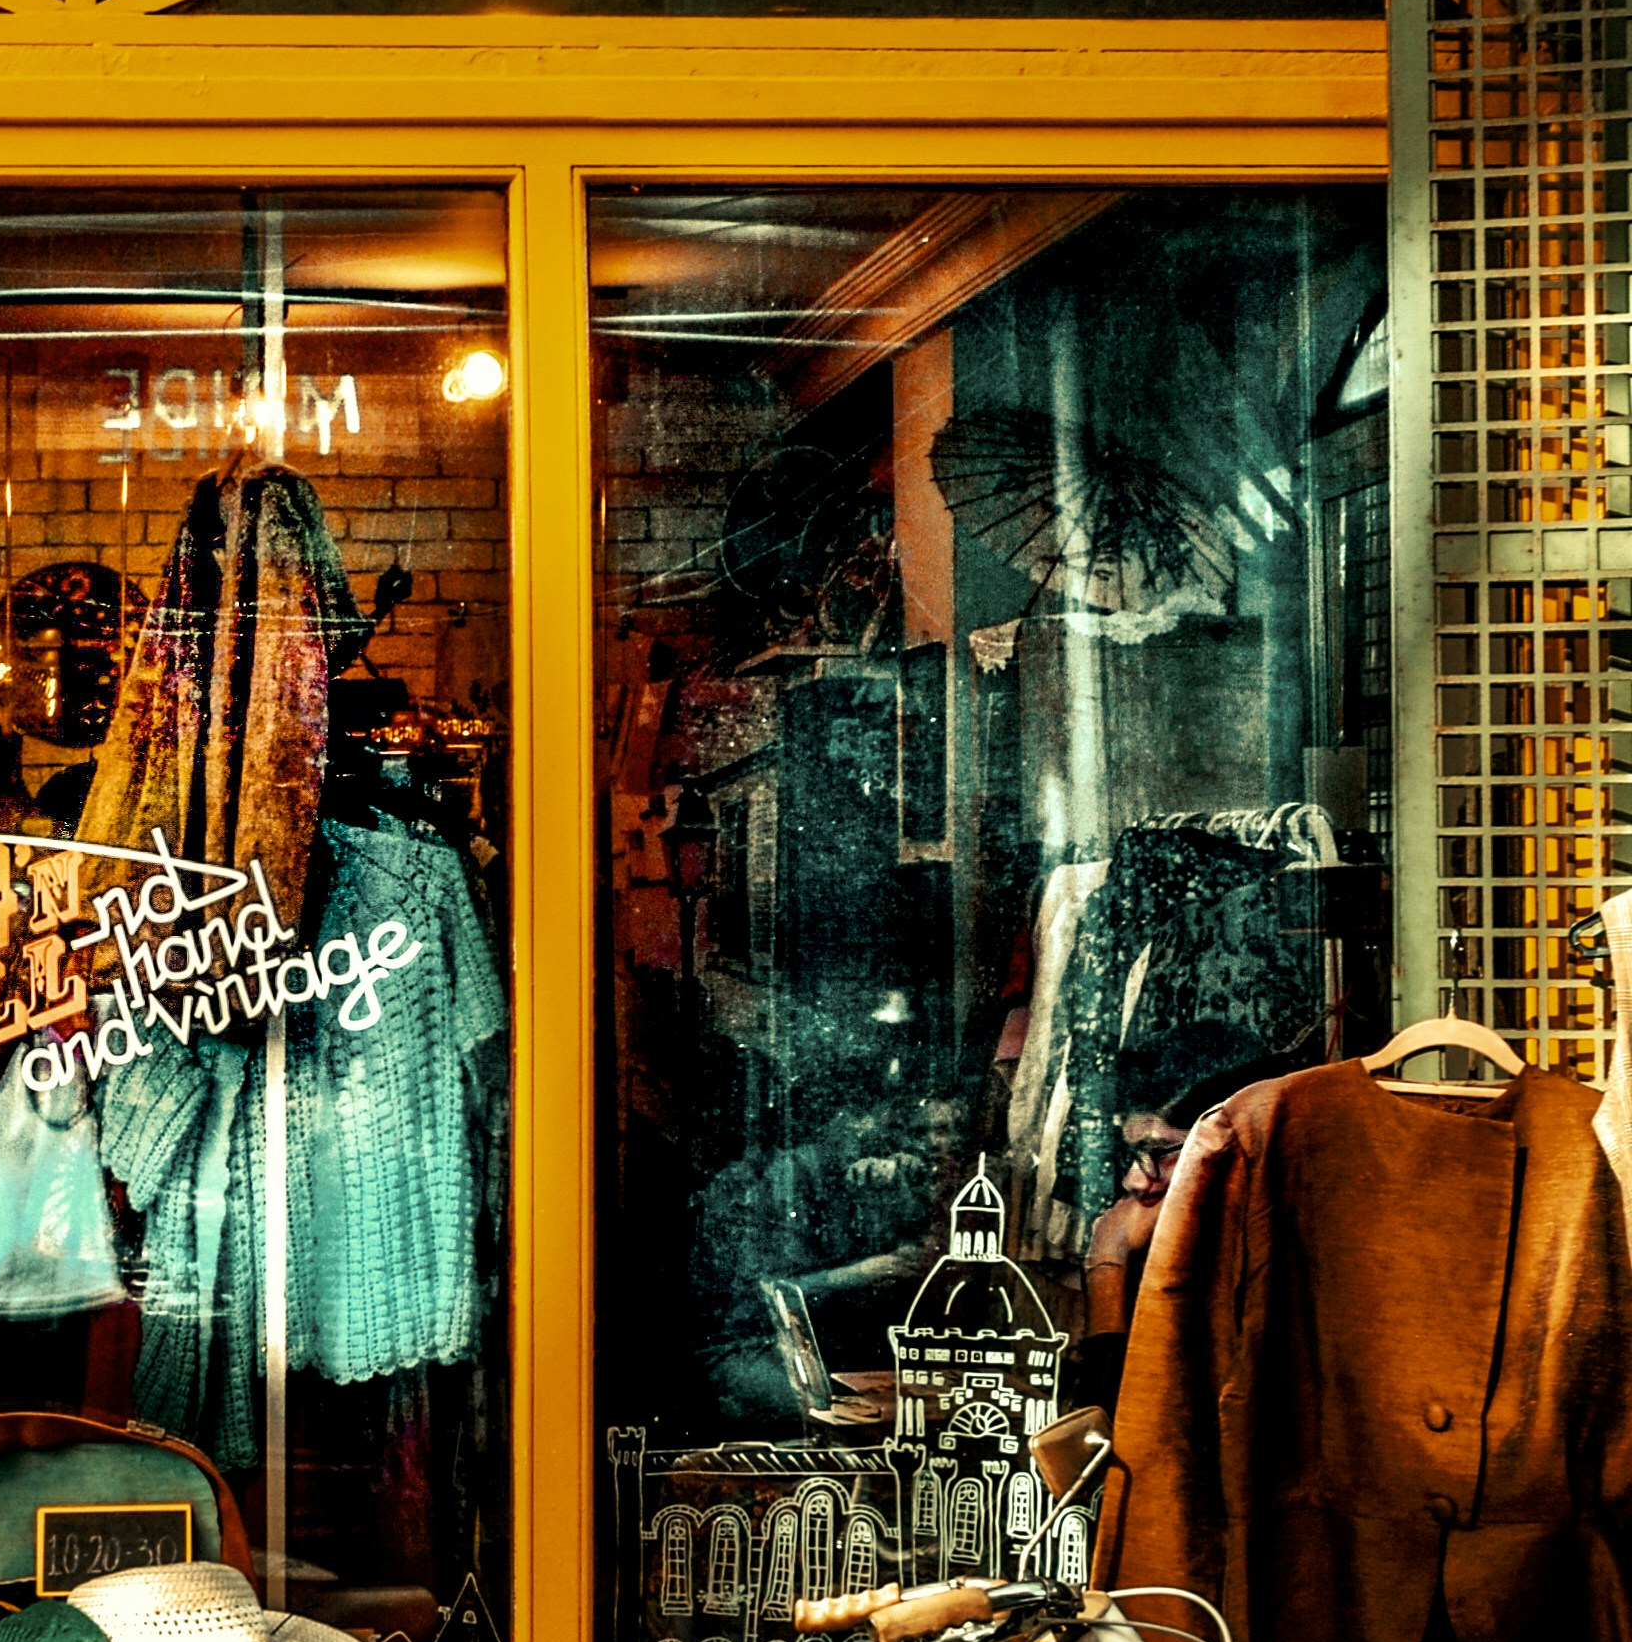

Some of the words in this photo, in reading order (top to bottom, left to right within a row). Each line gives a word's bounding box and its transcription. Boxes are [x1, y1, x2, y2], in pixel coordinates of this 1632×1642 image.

[115, 859, 295, 1009] hand
[145, 920, 423, 1032] vintage
[21, 978, 153, 1092] and
